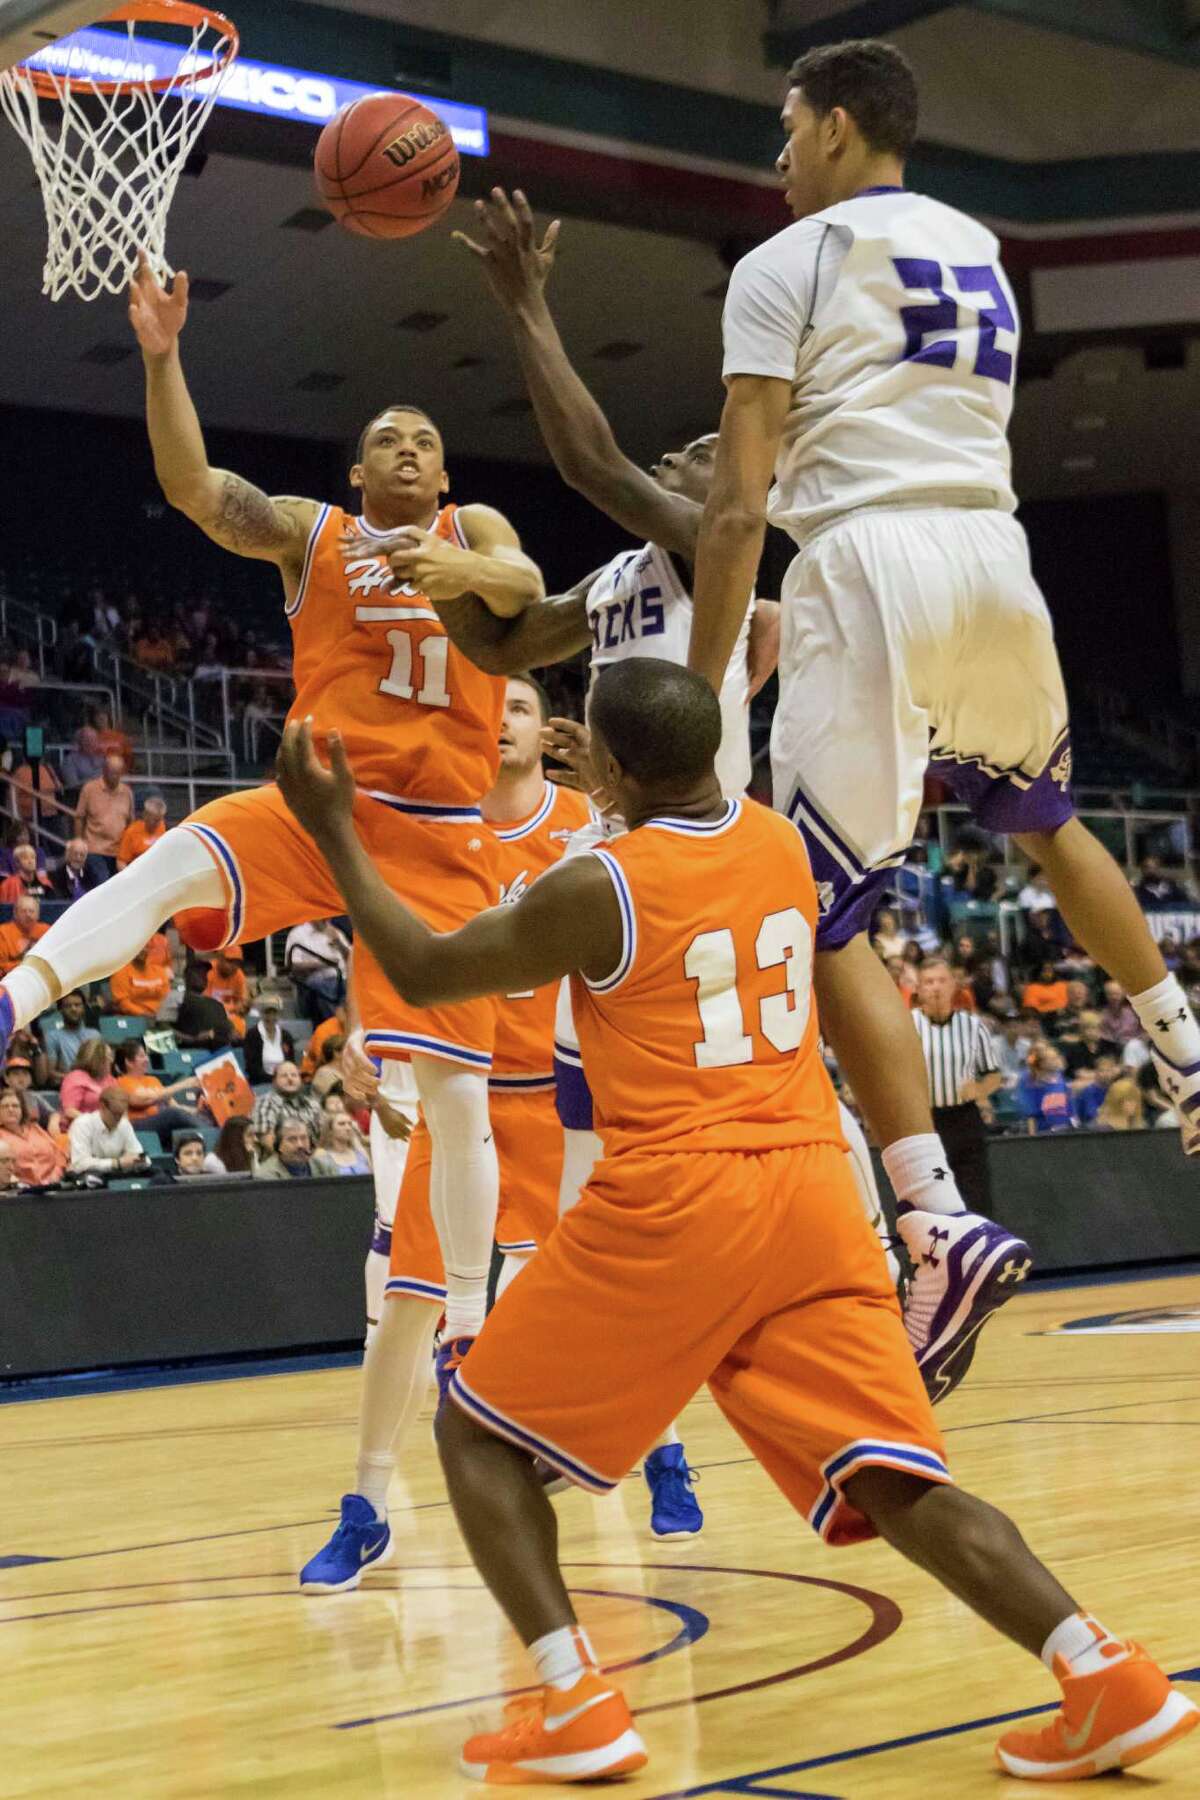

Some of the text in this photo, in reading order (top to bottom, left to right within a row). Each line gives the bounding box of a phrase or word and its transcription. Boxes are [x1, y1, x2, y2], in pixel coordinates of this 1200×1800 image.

[891, 257, 1016, 385] 22
[378, 628, 452, 708] 11
[683, 905, 814, 1069] 13
